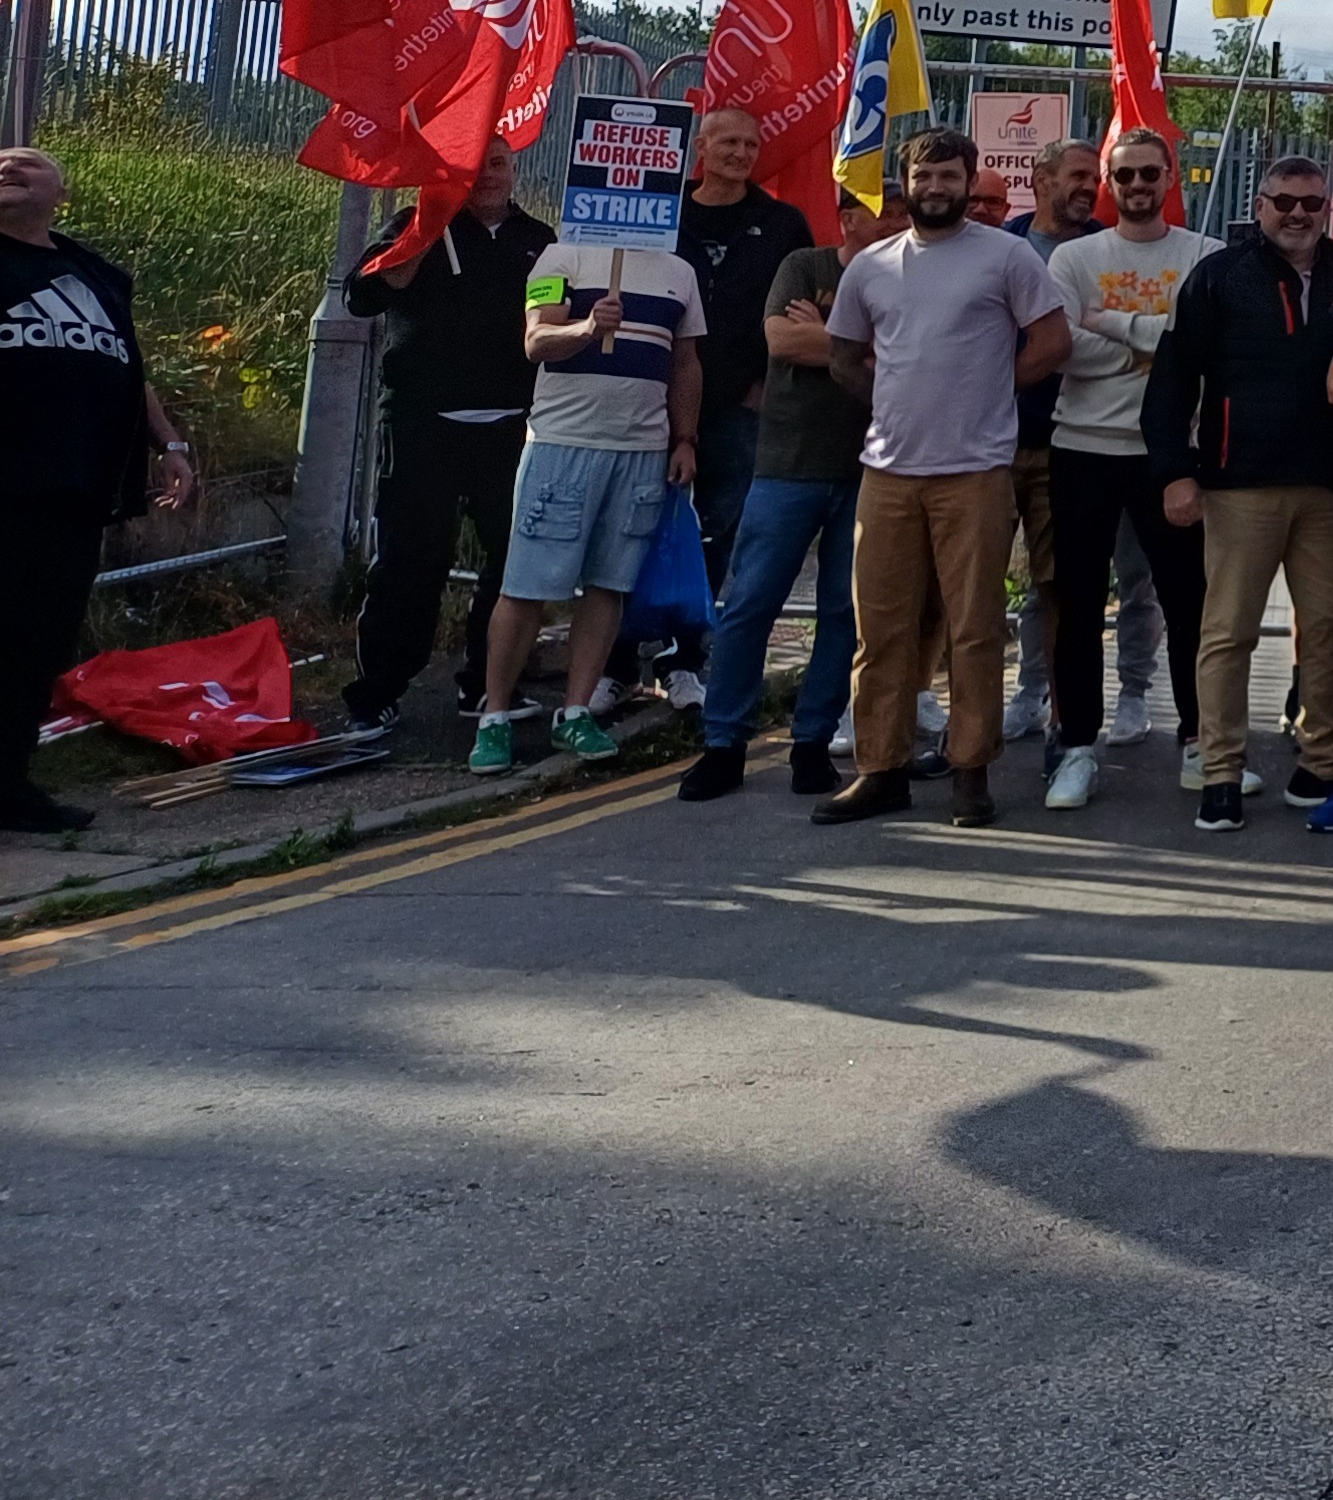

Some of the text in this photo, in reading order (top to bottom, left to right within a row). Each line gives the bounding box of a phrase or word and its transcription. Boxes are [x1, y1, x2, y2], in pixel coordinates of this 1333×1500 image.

[917, 2, 955, 26] nly
[962, 8, 1019, 28] past
[1027, 10, 1074, 32] this
[592, 122, 671, 148] REFUSE
[579, 143, 679, 170] WORKERS
[984, 154, 1036, 169] OFFICI
[611, 167, 640, 187] ON
[572, 192, 672, 226] STRIKE
[0, 318, 129, 364] adidas
